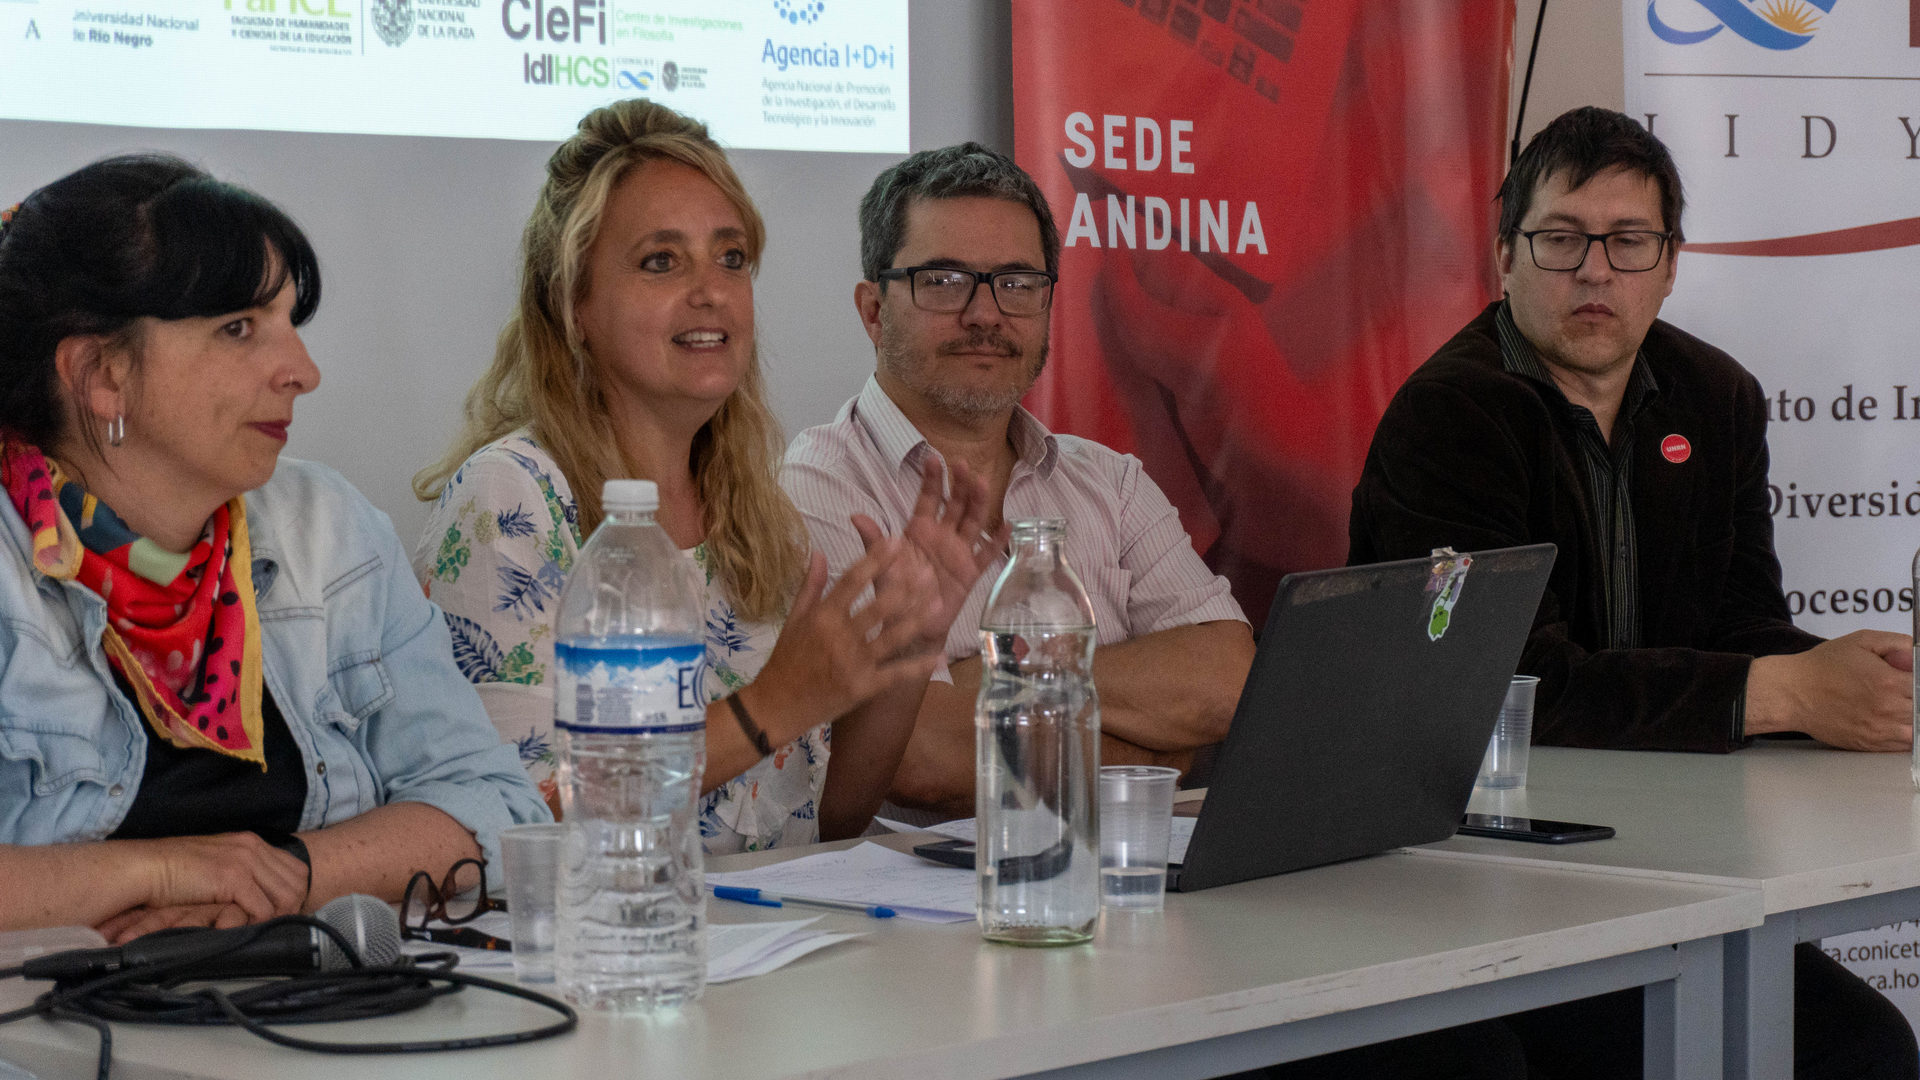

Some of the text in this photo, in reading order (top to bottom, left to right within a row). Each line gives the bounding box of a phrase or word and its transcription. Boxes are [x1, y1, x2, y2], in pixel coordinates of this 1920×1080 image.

[147, 14, 199, 31] Nacional
[231, 15, 349, 31] FACULTAD DE HUMANIDADES
[417, 8, 465, 23] NACIONAL
[616, 9, 743, 31] Centro de Investigaciones
[114, 31, 153, 48] Negro
[418, 24, 475, 40] DE LA PLATA
[761, 38, 840, 72] Agencia
[761, 77, 796, 92] Agencia
[797, 79, 833, 94] Nacional
[1064, 111, 1195, 174] SEDE
[1064, 192, 1269, 255] ANDINA
[1831, 384, 1878, 421] de
